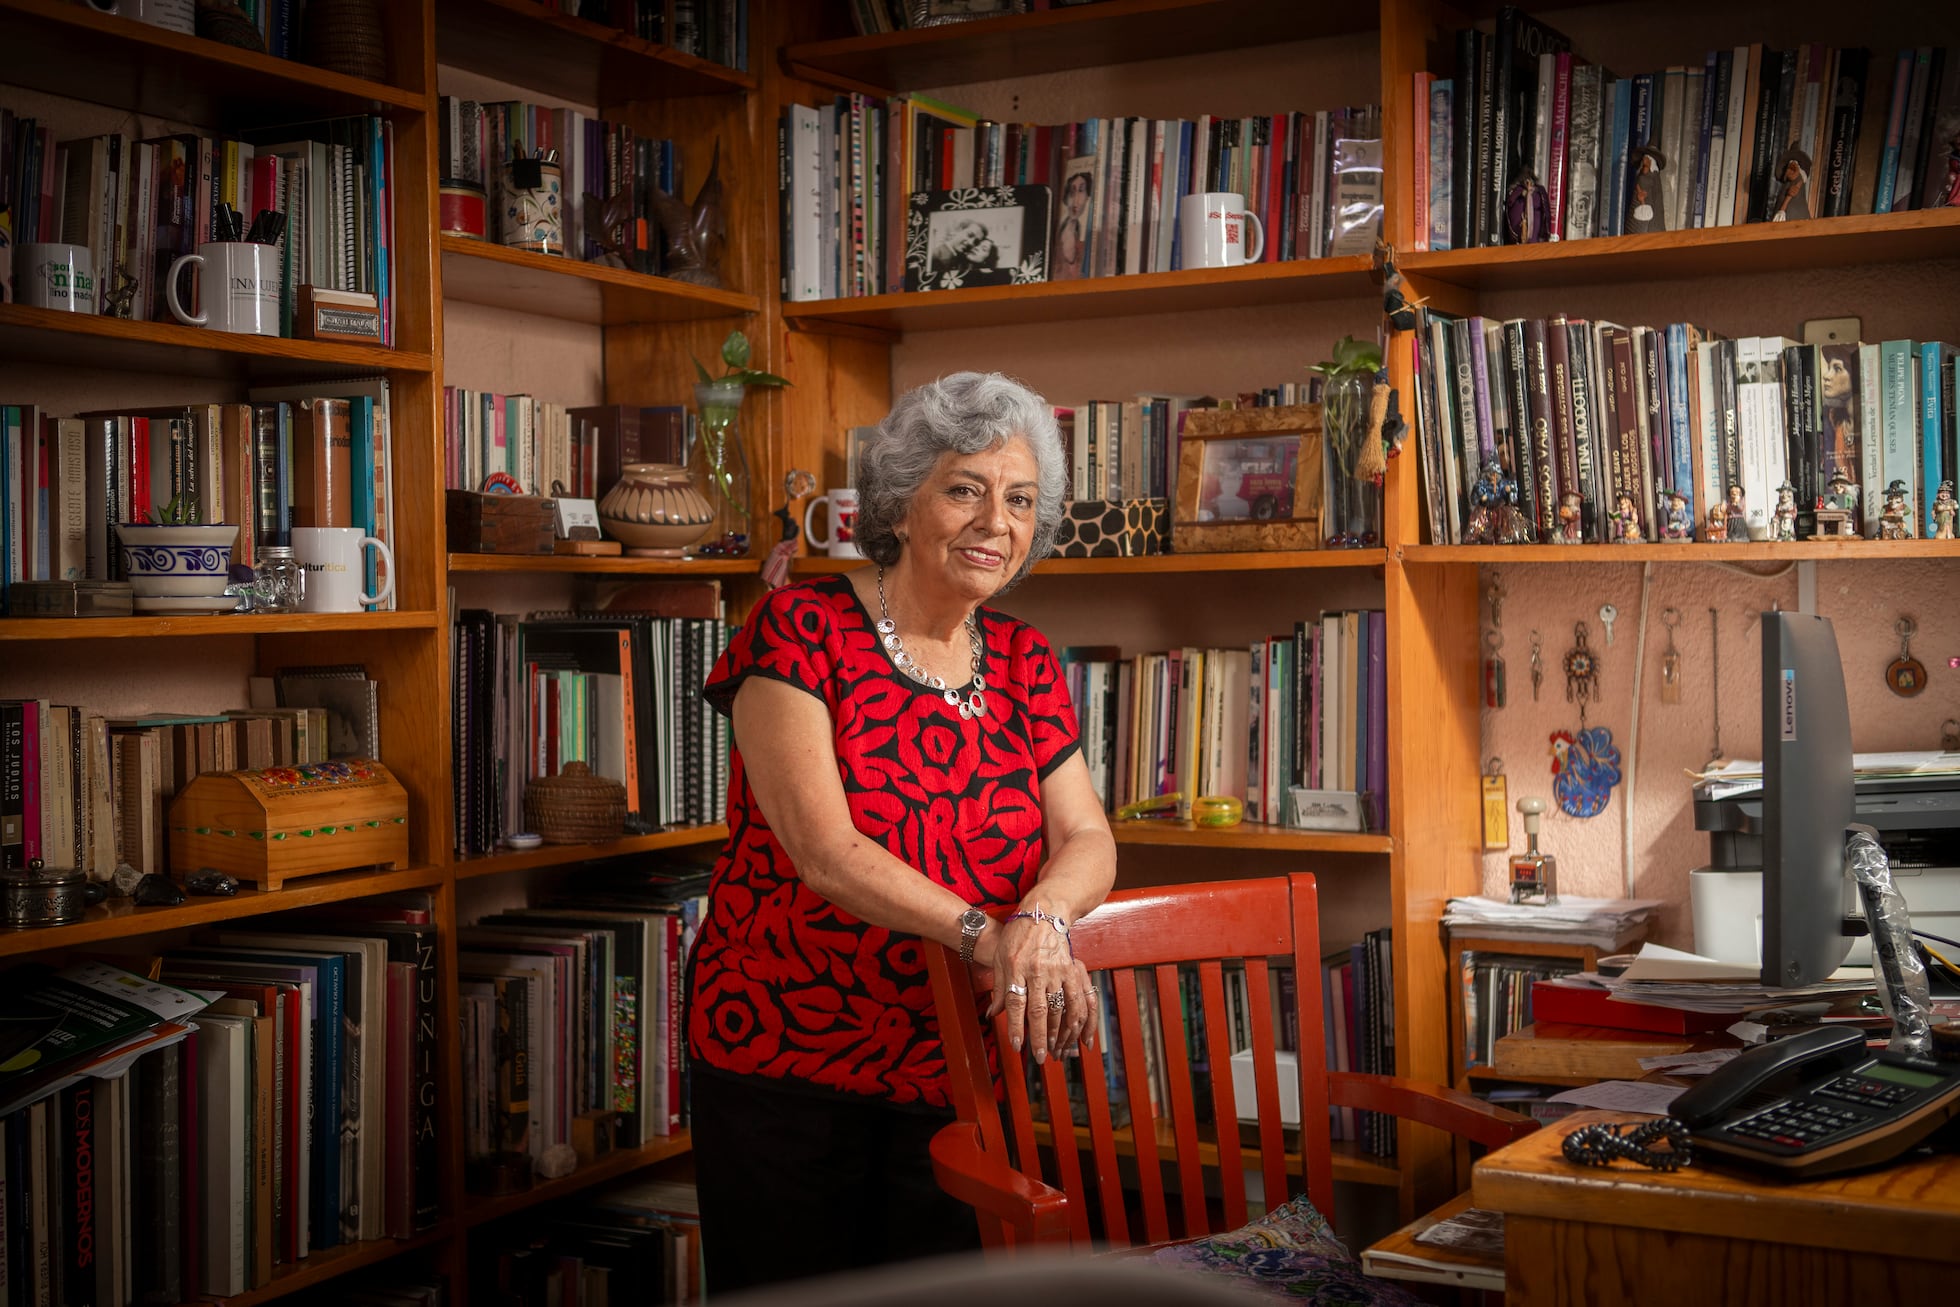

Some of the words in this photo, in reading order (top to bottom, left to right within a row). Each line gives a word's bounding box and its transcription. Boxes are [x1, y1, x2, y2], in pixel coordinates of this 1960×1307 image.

[1556, 71, 1568, 125] MALINCHE
[1495, 110, 1504, 150] MONROE
[1832, 139, 1844, 167] Garbo
[1493, 151, 1503, 192] MARILYN
[1830, 170, 1842, 195] Greta
[1509, 329, 1519, 370] FERDINAND
[1887, 353, 1897, 389] MUJERES
[1896, 352, 1905, 380] FELIPE
[1556, 363, 1567, 415] ACTIVIDADES
[1791, 374, 1799, 398] Historia
[1896, 381, 1905, 406] PIGNA
[1572, 378, 1588, 438] MODOTTI
[1804, 405, 1813, 432] Historias
[1887, 390, 1898, 420] TENÍAN
[1927, 397, 1936, 419] Evita
[187, 417, 195, 448] lenguaje
[1535, 417, 1549, 460] VARO
[1560, 417, 1568, 434] SUS
[1868, 417, 1878, 447] Leyenda
[1888, 421, 1897, 437] QUE
[1621, 432, 1629, 450] LOS
[1709, 407, 1721, 488] PEREGRINA
[1889, 438, 1897, 454] SER
[67, 431, 81, 483] AMISTOSO
[1577, 442, 1590, 471] TINA
[1612, 450, 1621, 474] MAYO
[1868, 454, 1877, 480] Verdad
[1522, 466, 1531, 490] MUJER
[1538, 465, 1554, 529] REMEDIOS
[67, 490, 82, 541] PRESENTE
[1784, 676, 1794, 734] Lenovo
[11, 722, 21, 745] LOS
[10, 753, 20, 800] JUDIOS
[331, 1001, 339, 1016] PAZ
[419, 945, 436, 1142] ZUÑIGA
